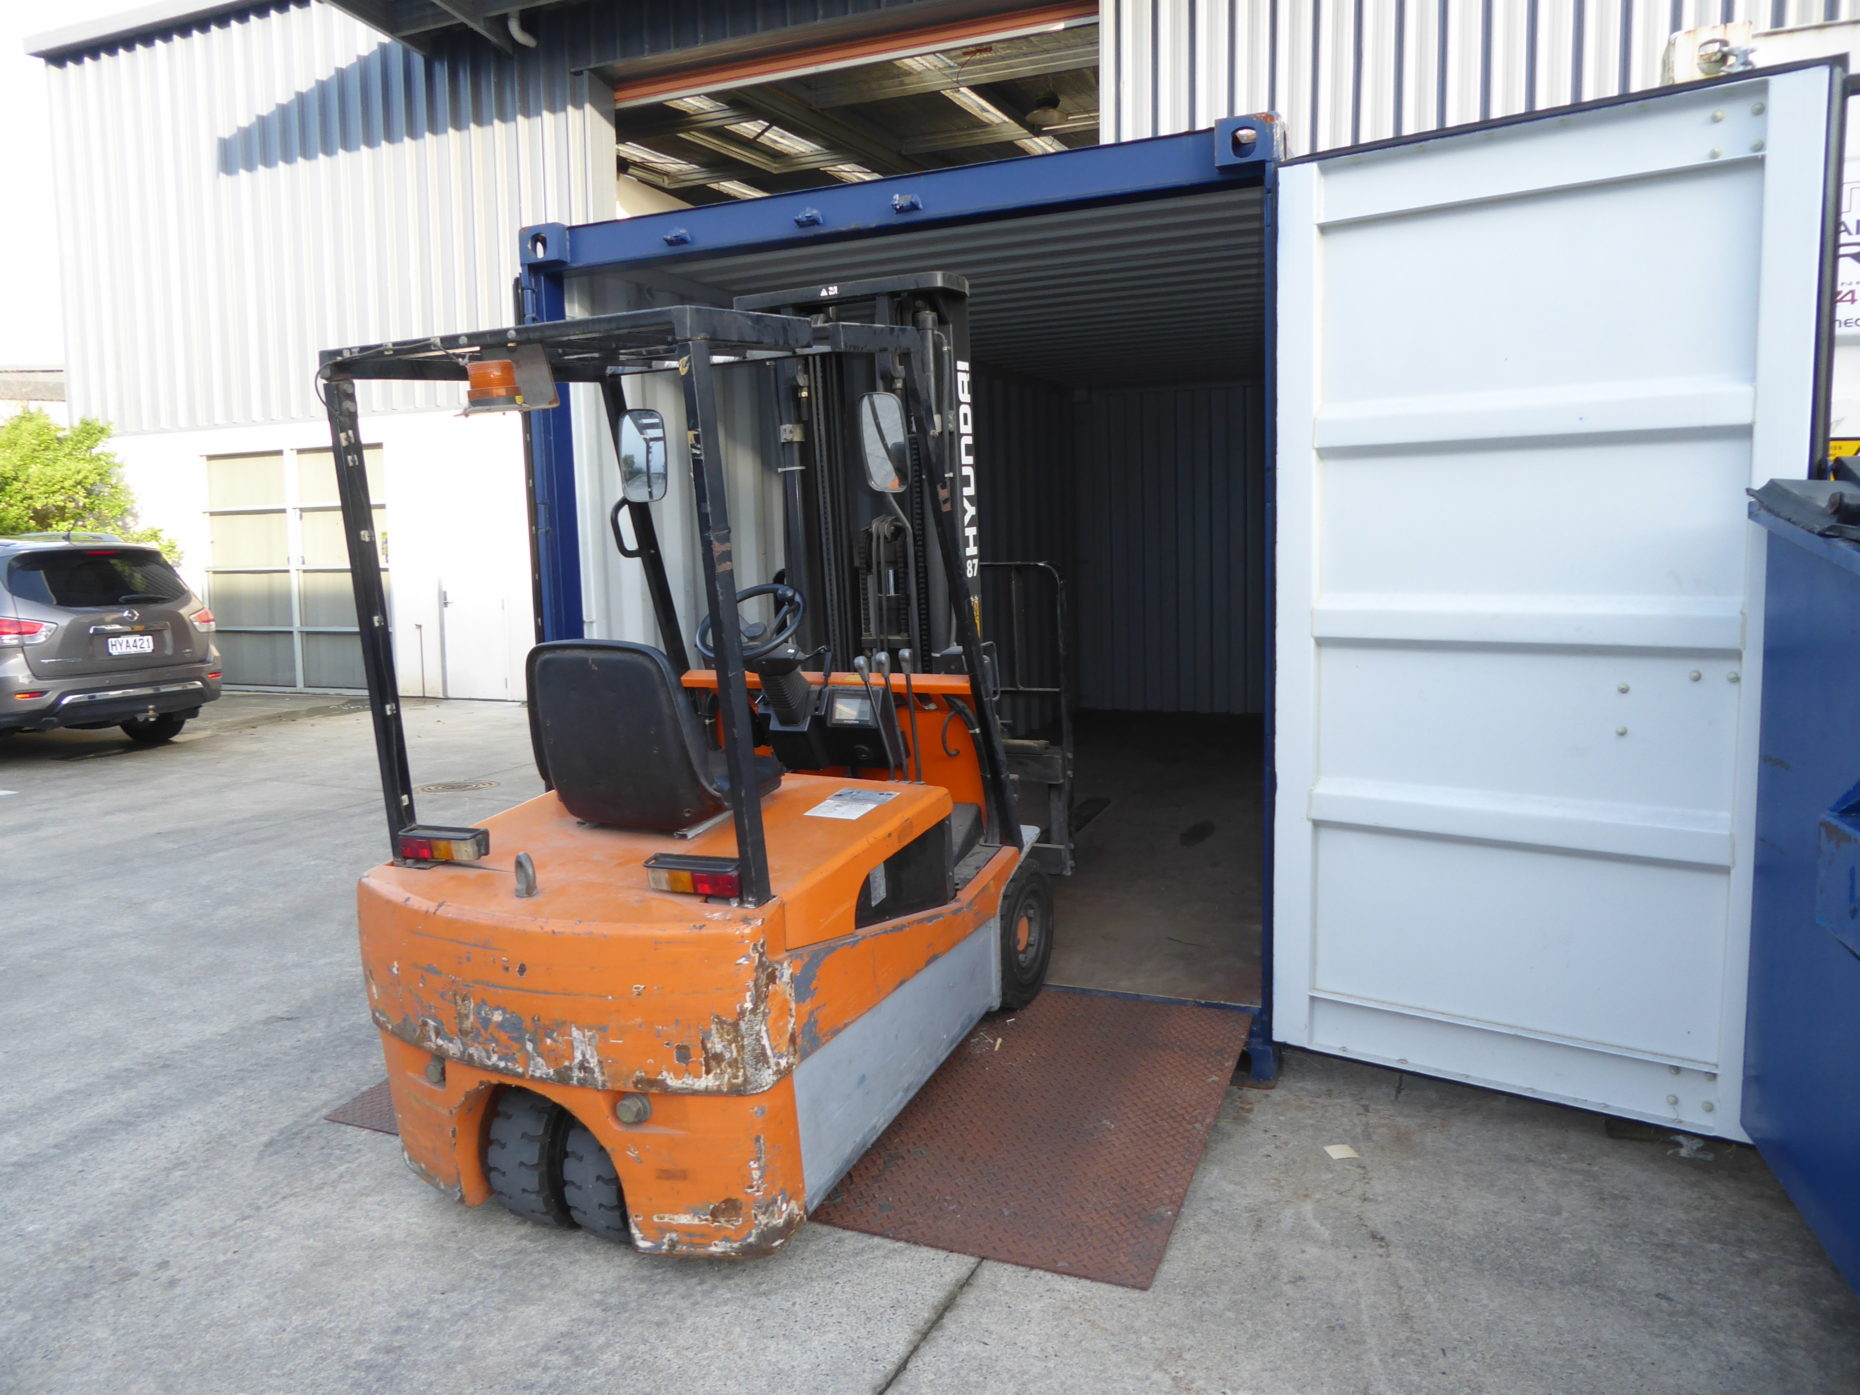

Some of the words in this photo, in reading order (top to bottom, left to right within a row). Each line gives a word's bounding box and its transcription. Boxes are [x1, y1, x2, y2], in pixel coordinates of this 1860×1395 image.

[957, 360, 978, 556] HYUNDAI
[966, 559, 978, 578] 87
[110, 637, 151, 652] HYA421
